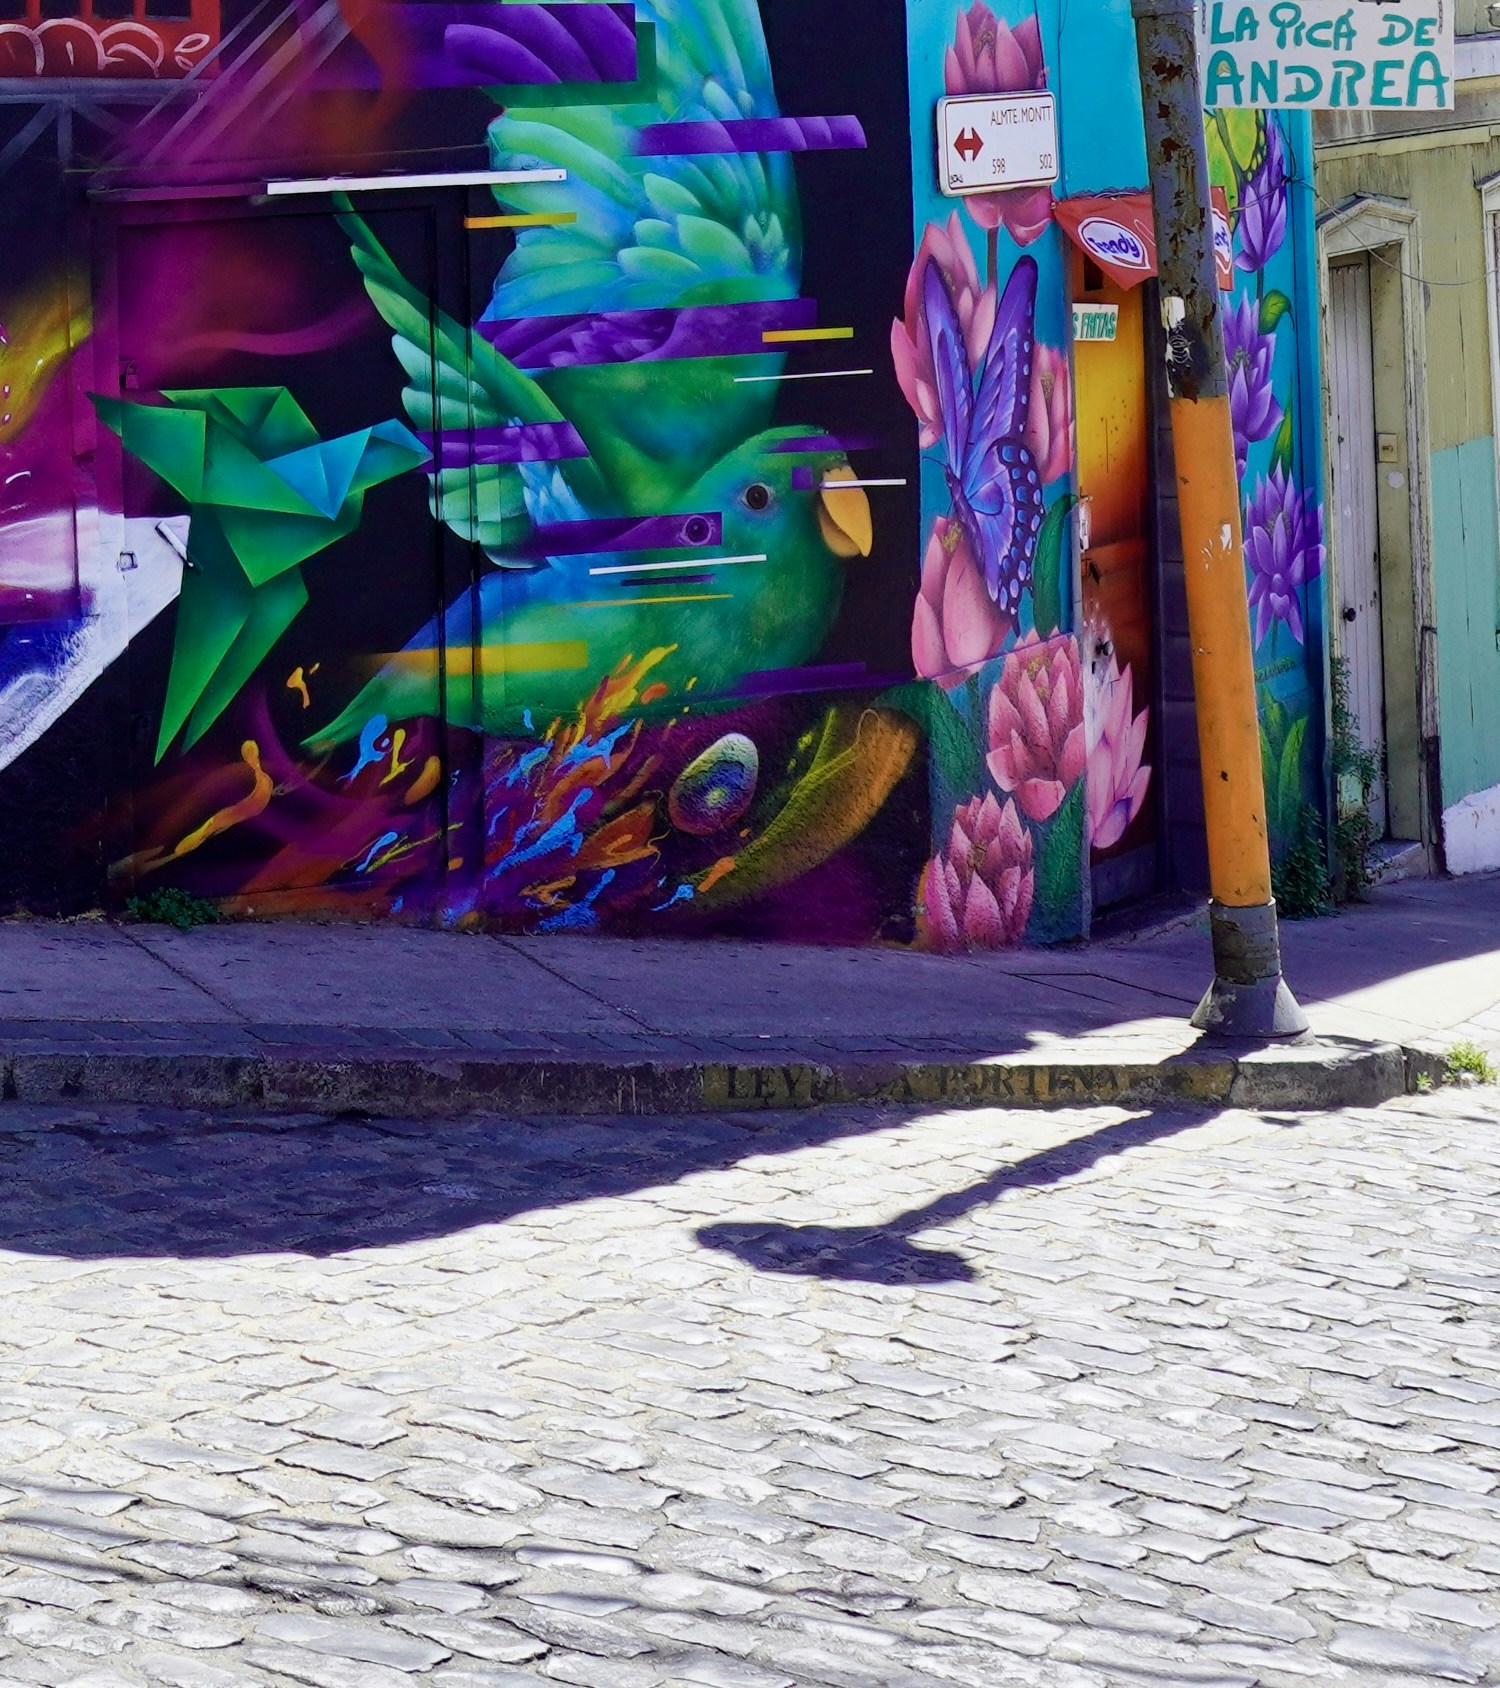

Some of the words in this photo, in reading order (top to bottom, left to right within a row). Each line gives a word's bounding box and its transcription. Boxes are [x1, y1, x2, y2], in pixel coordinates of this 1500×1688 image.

[1210, 2, 1260, 45] LA
[1378, 14, 1438, 47] DE
[1205, 50, 1449, 107] ANDREA
[992, 158, 1006, 174] 598
[1039, 153, 1053, 169] 502
[1080, 312, 1116, 339] FRITAS
